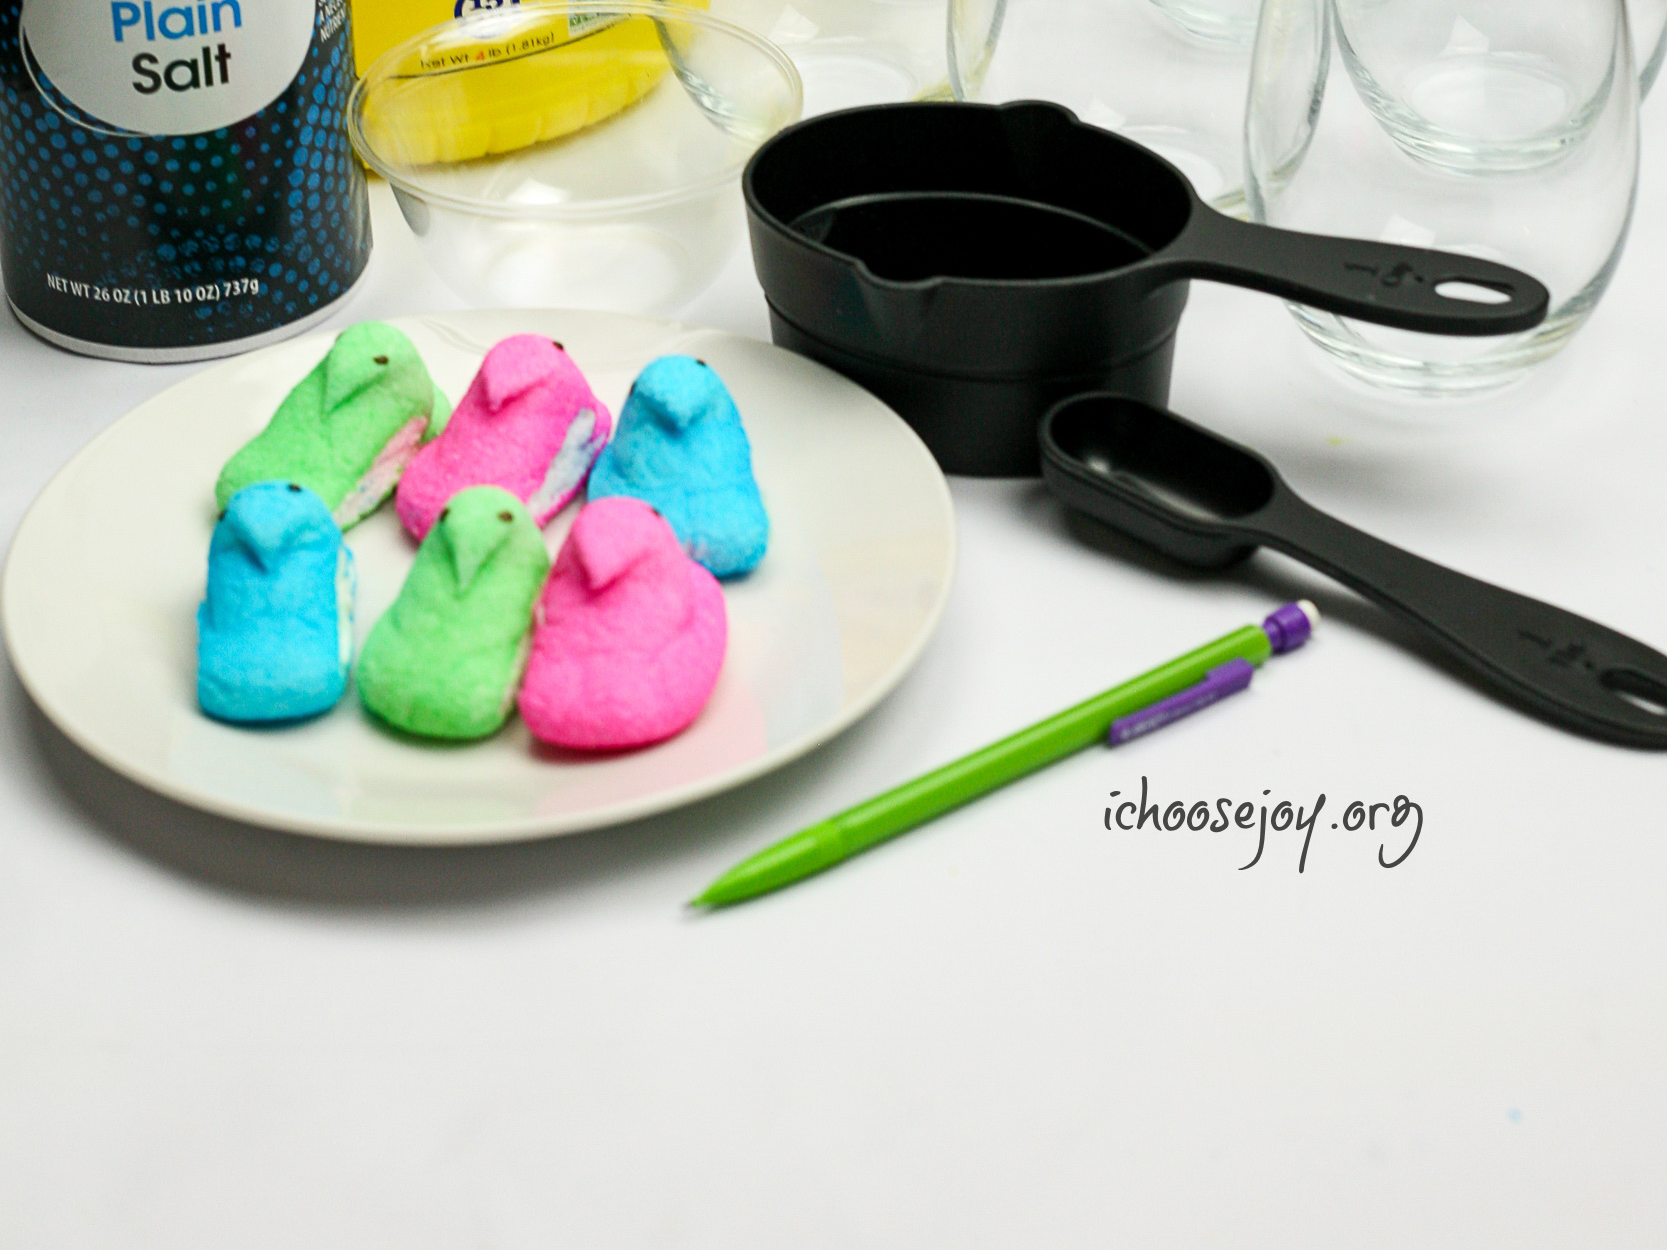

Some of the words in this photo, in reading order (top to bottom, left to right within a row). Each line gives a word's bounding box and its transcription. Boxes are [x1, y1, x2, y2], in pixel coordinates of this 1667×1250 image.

[131, 43, 232, 95] Salt
[475, 50, 485, 61] 4
[46, 273, 68, 293] NET
[69, 281, 90, 298] WT
[93, 285, 110, 302] 26
[112, 288, 132, 304] OZ
[133, 289, 148, 306] (1
[151, 289, 171, 305] LB
[175, 287, 193, 303] 10
[195, 284, 221, 301] OZ)
[223, 277, 260, 298] 737g
